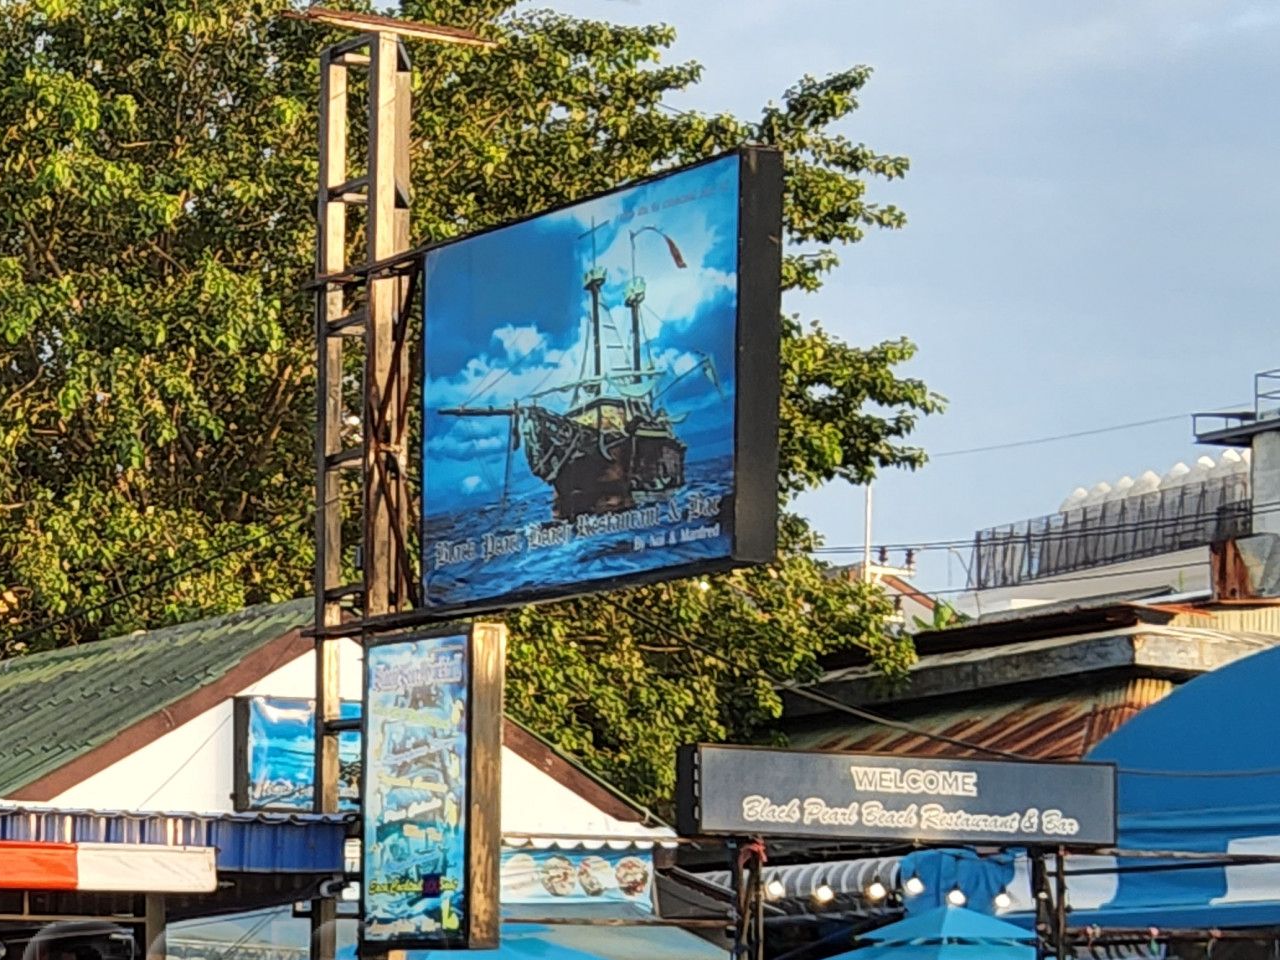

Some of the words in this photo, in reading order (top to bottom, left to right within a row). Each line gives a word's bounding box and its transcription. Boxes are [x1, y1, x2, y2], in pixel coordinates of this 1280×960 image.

[850, 766, 978, 797] WELCOME
[742, 795, 800, 823] Black
[803, 797, 859, 825] Pearl
[861, 800, 918, 828] Beach
[920, 803, 1021, 833] Restaurant
[1021, 808, 1039, 833] &
[1042, 809, 1080, 835] Bar
